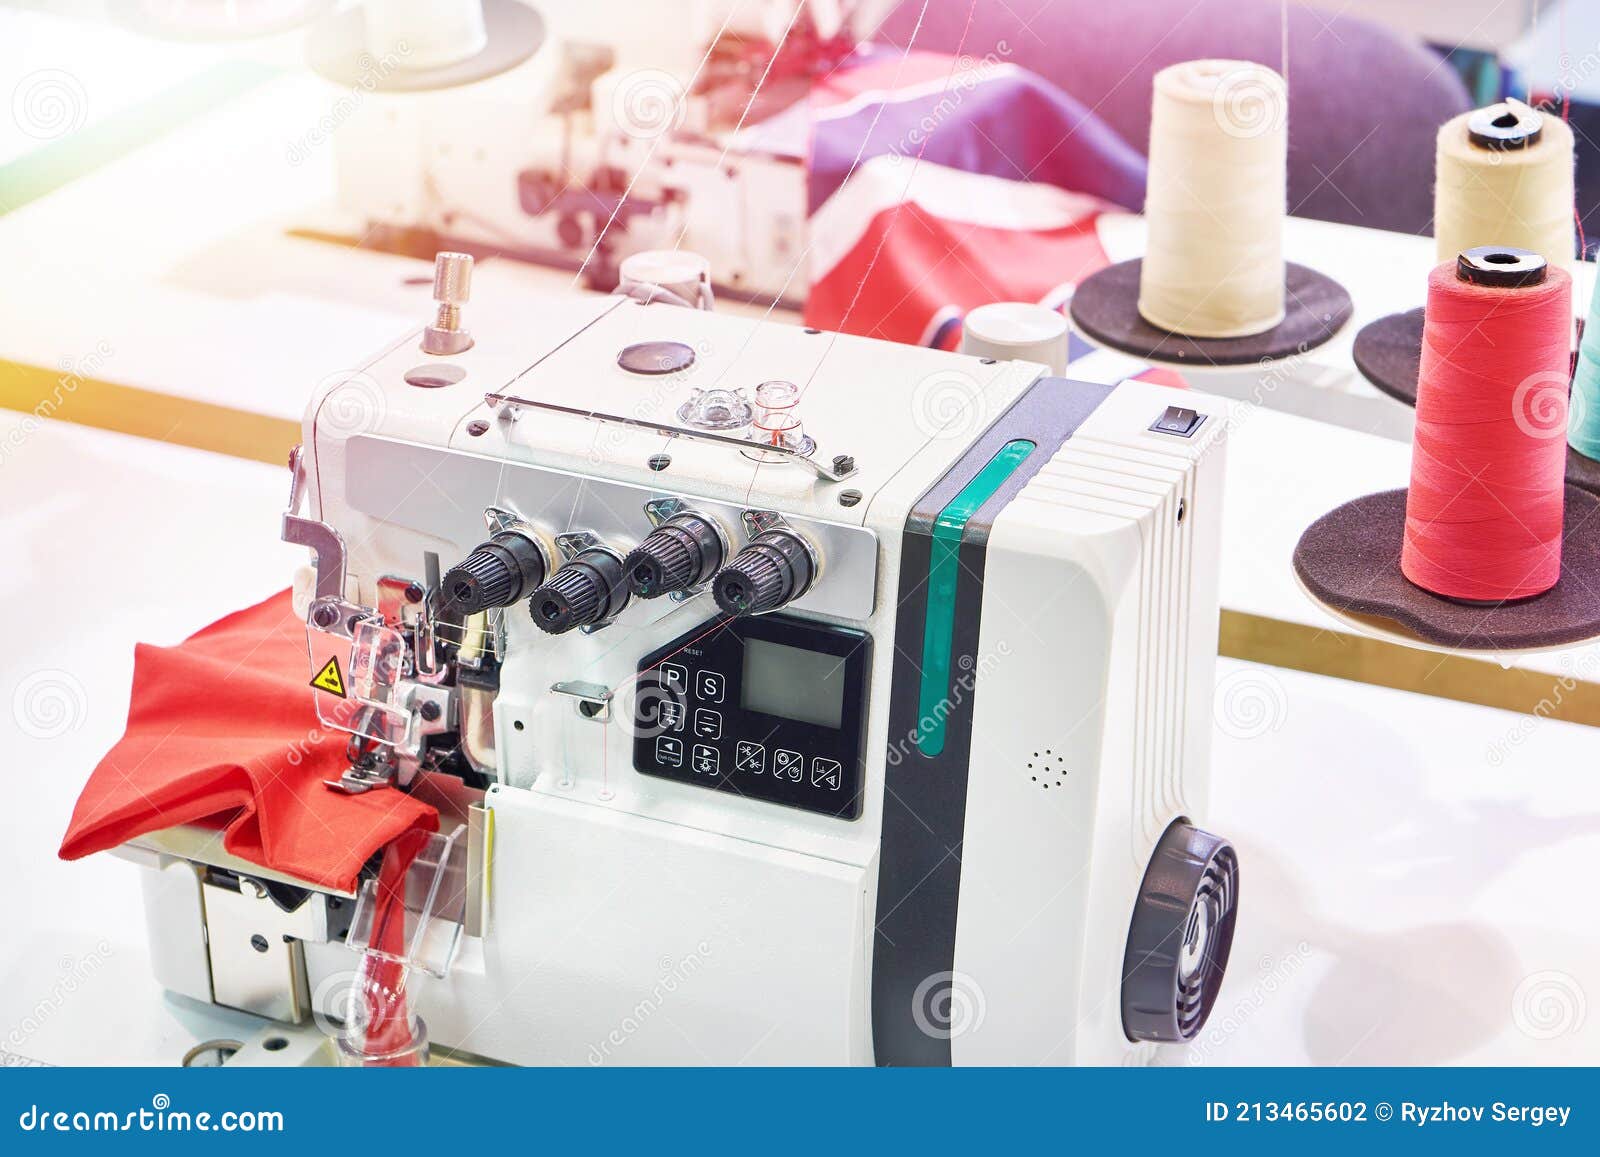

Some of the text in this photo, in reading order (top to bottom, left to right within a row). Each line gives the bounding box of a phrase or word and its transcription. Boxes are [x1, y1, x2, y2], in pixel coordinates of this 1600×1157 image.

[683, 647, 703, 657] RESET
[667, 669, 680, 686] P
[704, 678, 717, 695] S
